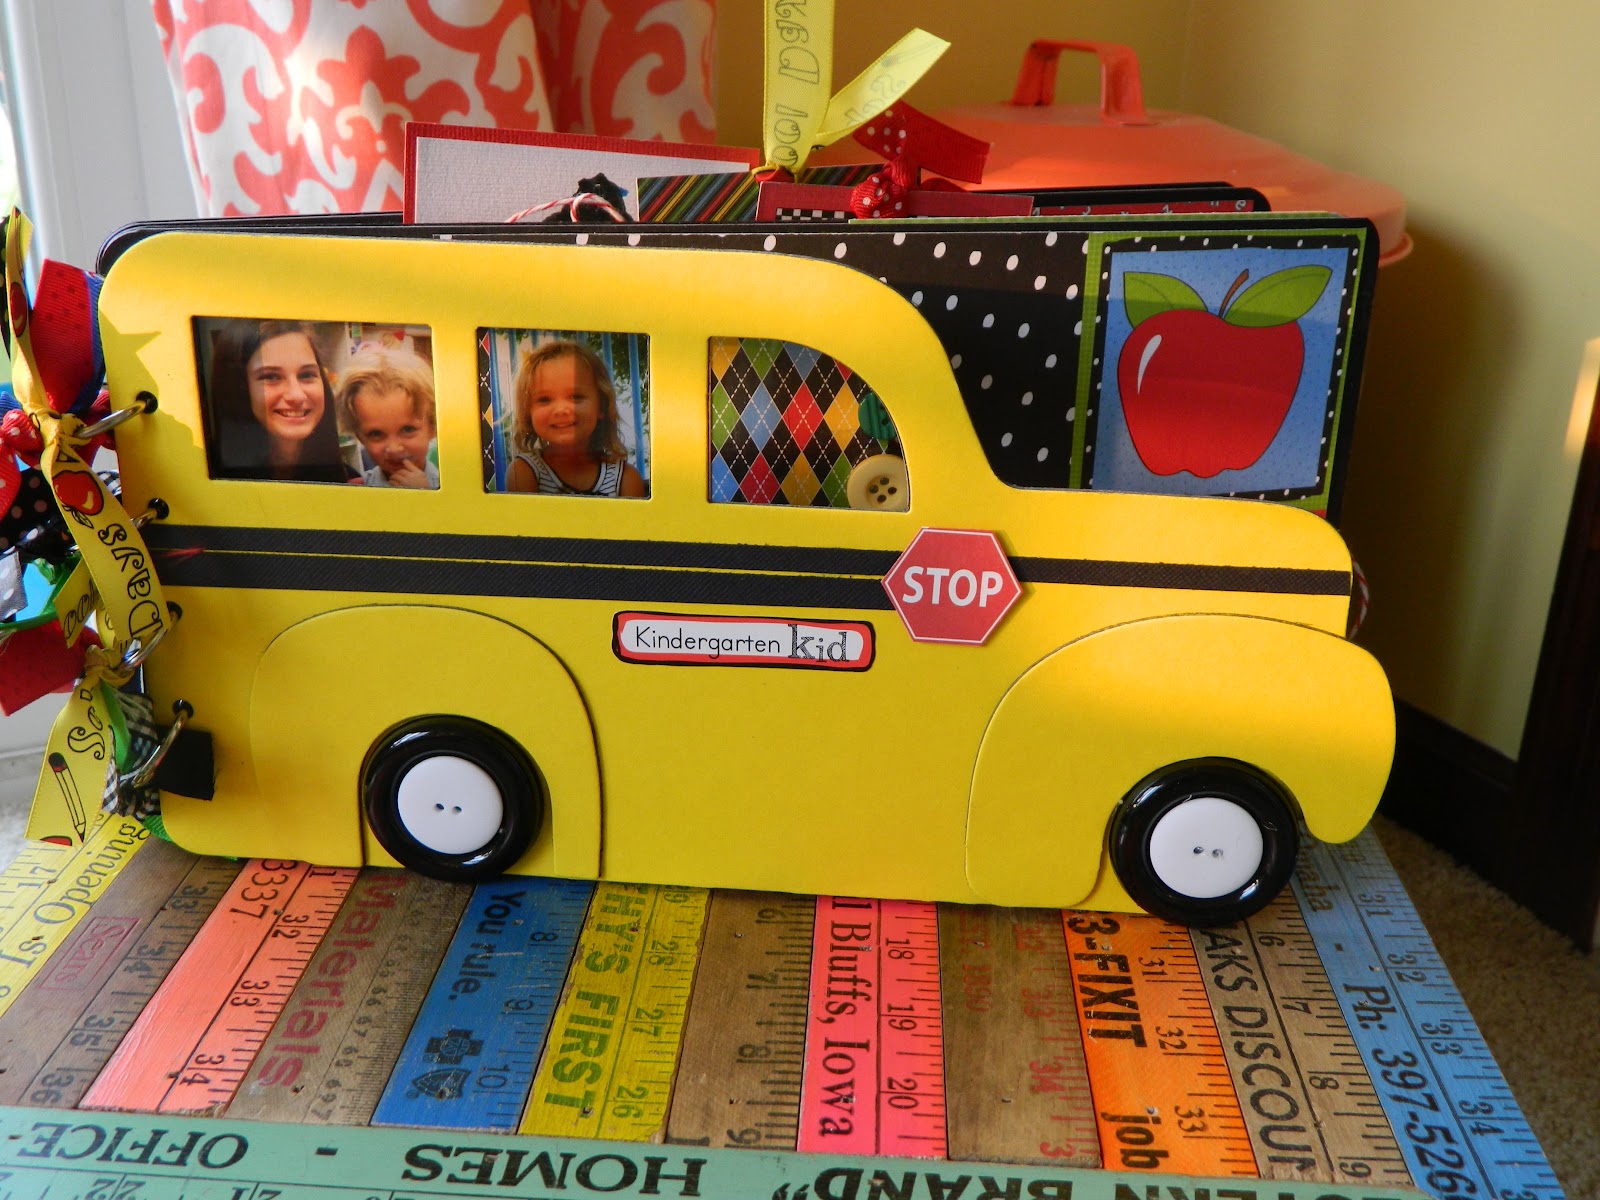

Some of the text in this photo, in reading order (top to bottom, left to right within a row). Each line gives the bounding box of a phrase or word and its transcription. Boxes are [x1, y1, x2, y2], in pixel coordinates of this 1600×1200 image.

[98, 523, 164, 638] Days
[902, 566, 1004, 608] STOP
[635, 624, 850, 663] Kindergarten kid
[0, 823, 151, 970] Is Opening
[18, 866, 57, 889] 17
[55, 924, 126, 984] Sears
[272, 914, 310, 938] 32
[448, 891, 527, 999] You rule.
[648, 940, 679, 967] 28
[258, 874, 406, 1087] Materials
[817, 920, 872, 1025] Bluffs,
[1067, 911, 1147, 1048] 3-FIXIT
[1200, 927, 1258, 992] AKS
[29, 885, 209, 1105] 33 34 35 36
[230, 979, 269, 1007] 33
[545, 885, 648, 1119] HY'S FIRST
[631, 1007, 664, 1038] 27
[1342, 982, 1397, 1031] Ph:
[885, 937, 919, 1110] 18 19 20
[1138, 956, 1206, 1133] 31 32 33
[1387, 953, 1427, 984] 32
[1420, 1022, 1464, 1056] 33
[1459, 1101, 1505, 1137] 34
[180, 1053, 225, 1087] 34
[476, 1064, 512, 1090] 10
[1030, 1060, 1064, 1094] 34
[1258, 935, 1372, 1179] 6 7 8 9
[612, 1084, 650, 1120] 26
[819, 1037, 870, 1138] Iowa
[17, 1122, 249, 1169] OFFICE
[1101, 1111, 1170, 1169] job
[401, 1144, 707, 1196] HOMES
